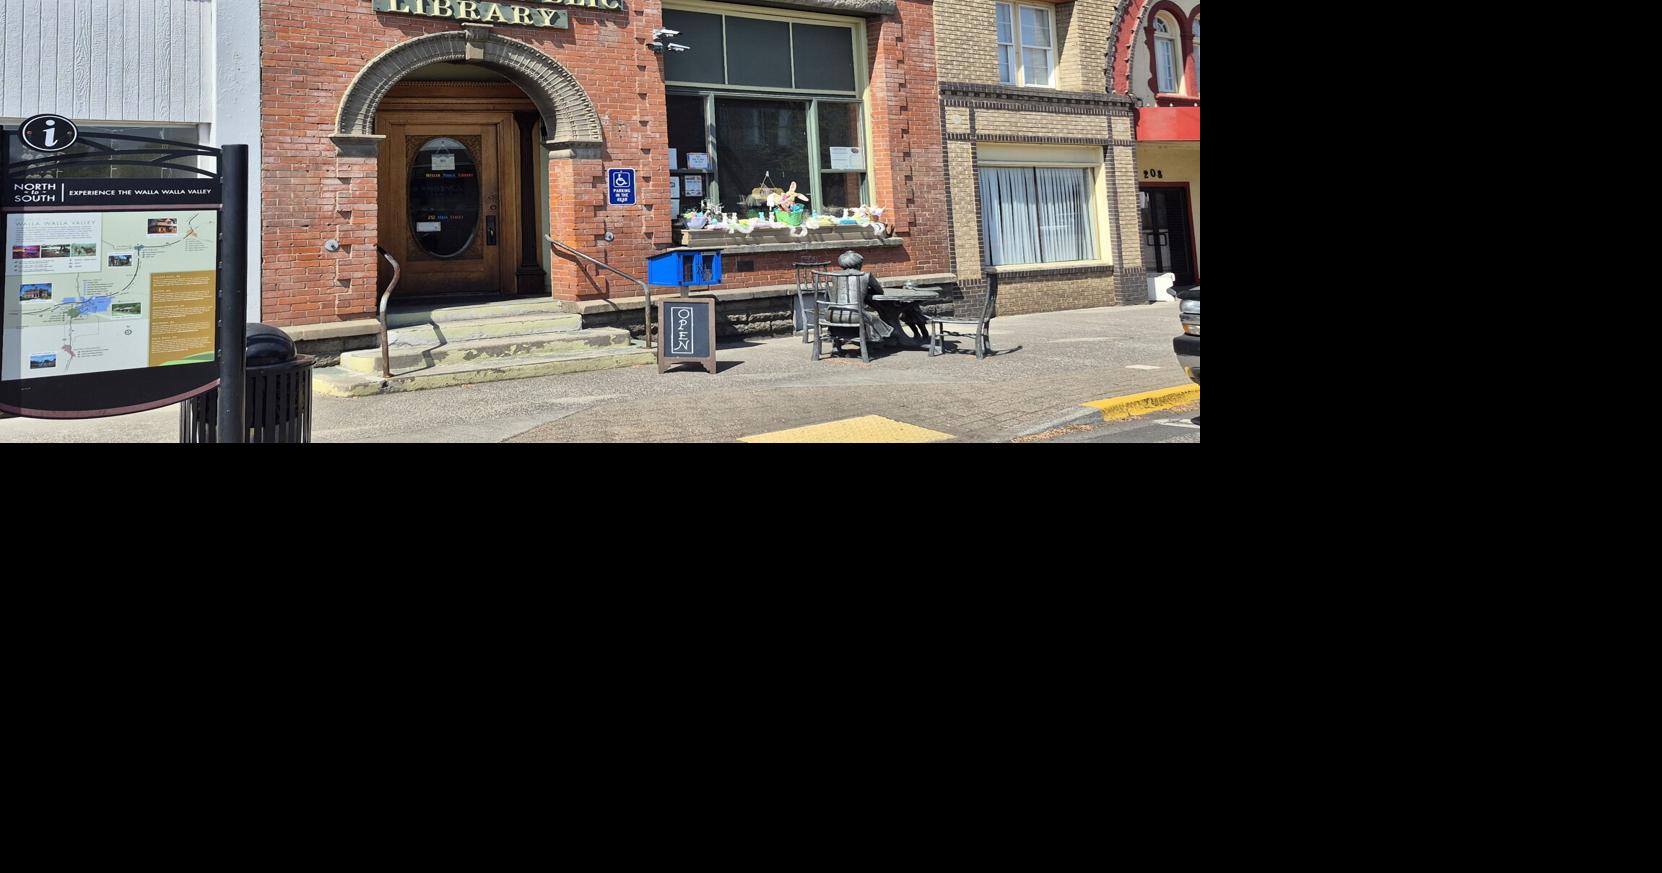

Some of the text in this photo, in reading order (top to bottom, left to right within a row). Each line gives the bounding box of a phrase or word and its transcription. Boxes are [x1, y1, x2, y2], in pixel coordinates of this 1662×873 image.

[387, 0, 557, 26] LIBRARY
[1143, 168, 1163, 179] 208
[14, 183, 56, 191] NORTH
[14, 194, 56, 202] SOUTH
[674, 308, 690, 351] OPEN
